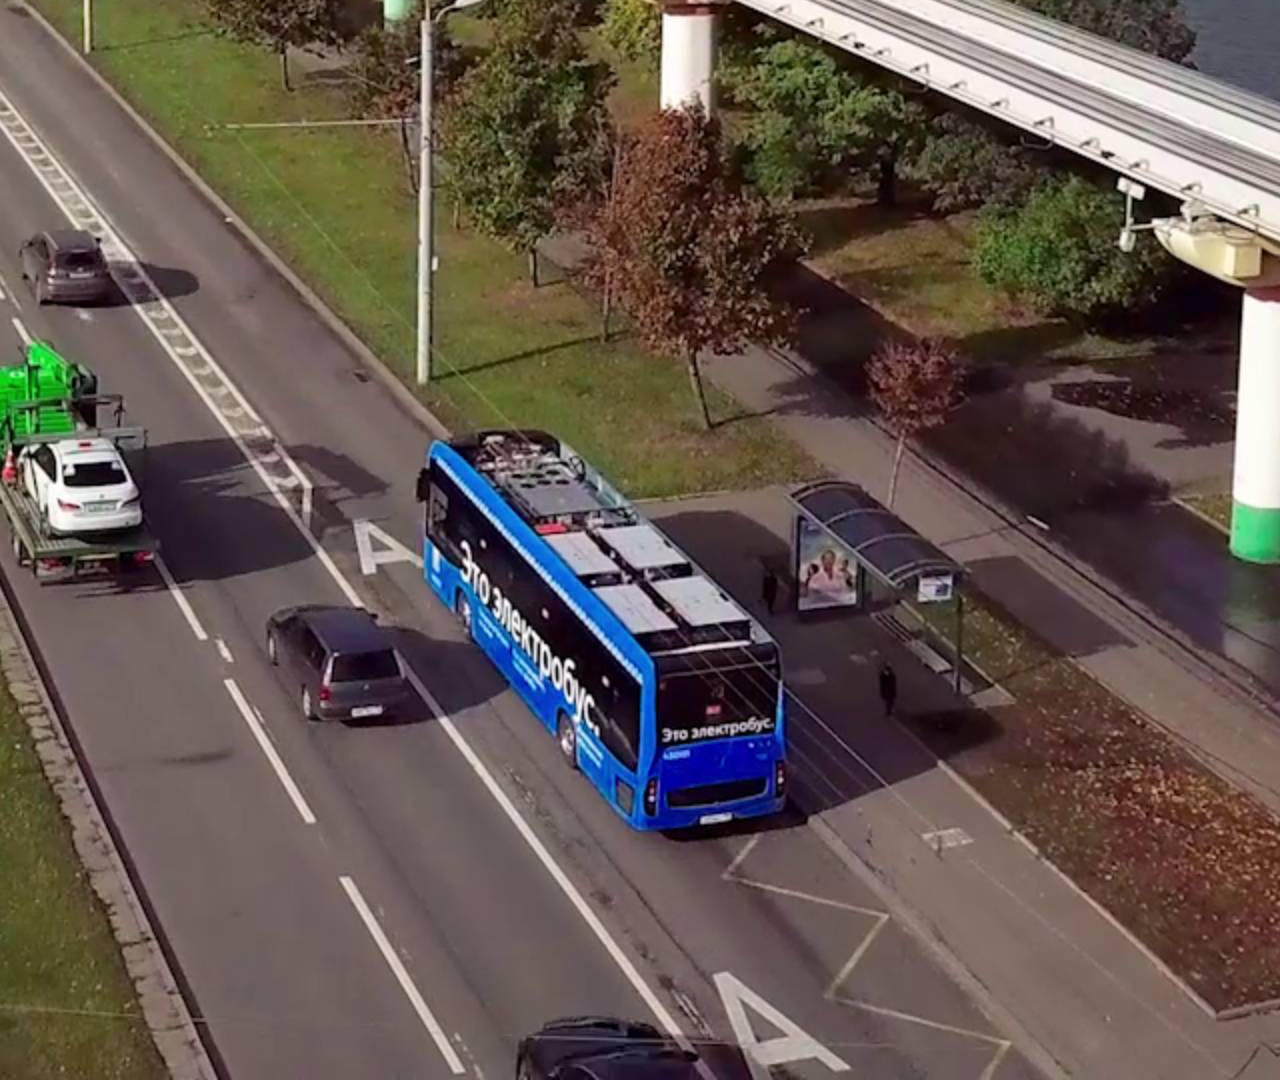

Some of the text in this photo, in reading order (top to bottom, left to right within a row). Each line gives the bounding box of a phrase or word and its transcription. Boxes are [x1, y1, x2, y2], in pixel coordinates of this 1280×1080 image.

[459, 540, 490, 605] Это
[491, 587, 601, 739] электробус.
[661, 716, 775, 744] Это электробус.
